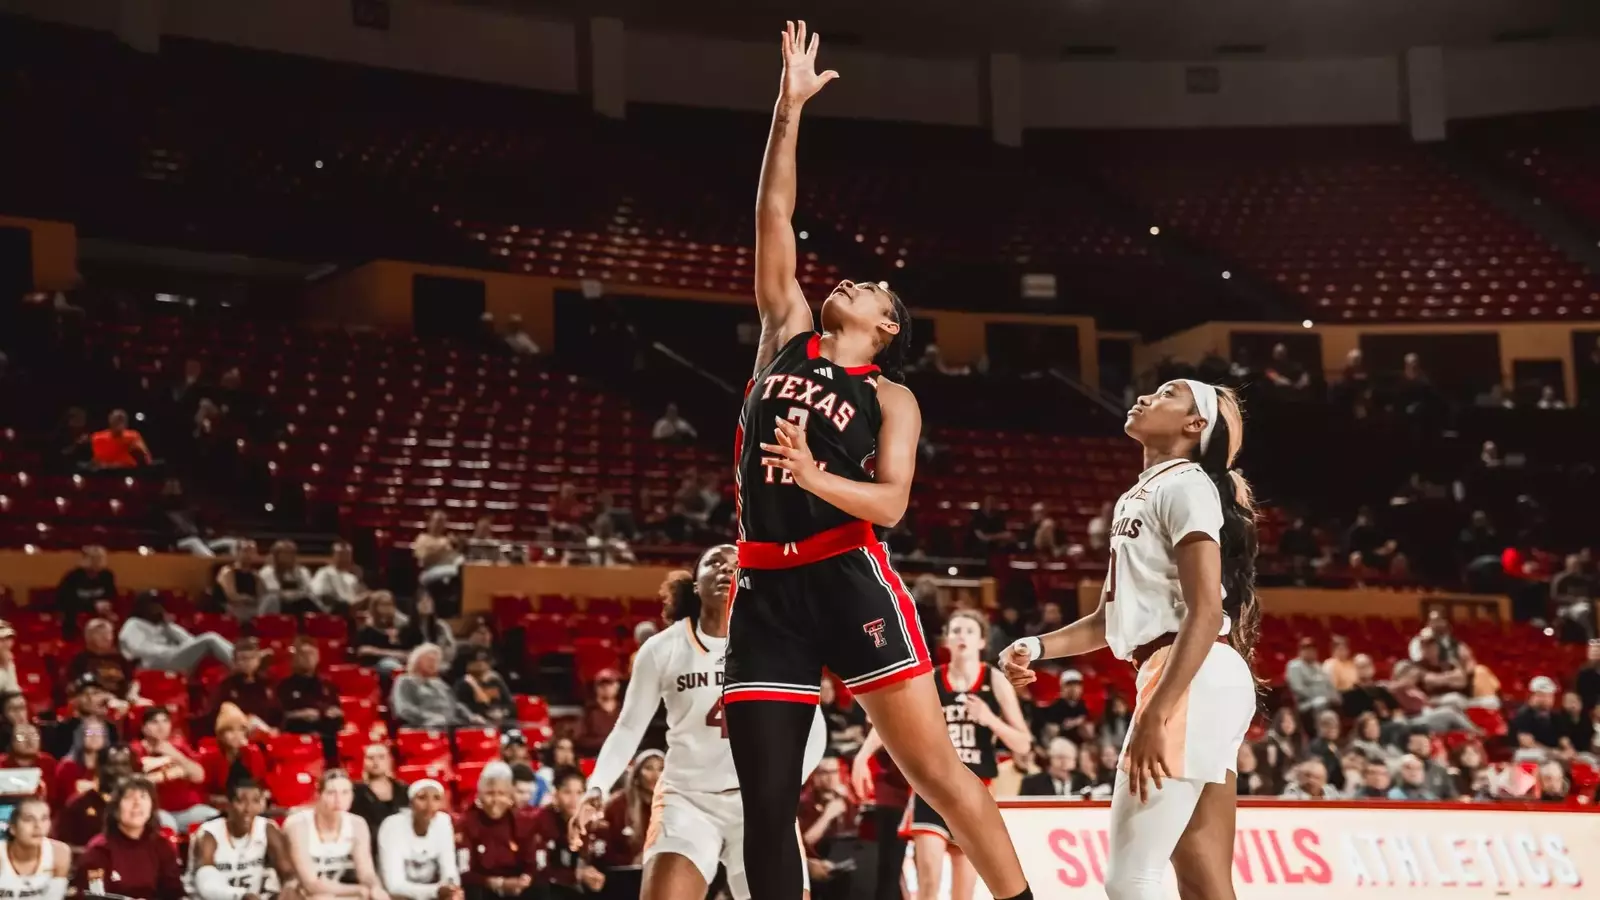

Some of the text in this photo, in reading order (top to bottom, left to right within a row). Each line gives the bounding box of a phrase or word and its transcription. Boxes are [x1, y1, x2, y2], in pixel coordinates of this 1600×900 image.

[760, 373, 856, 432] TEXAS
[676, 672, 709, 693] SUN
[705, 695, 729, 739] 4
[947, 723, 976, 748] 20
[955, 747, 982, 765] ECH
[1048, 828, 1584, 889] SU VILS ATHLETICS
